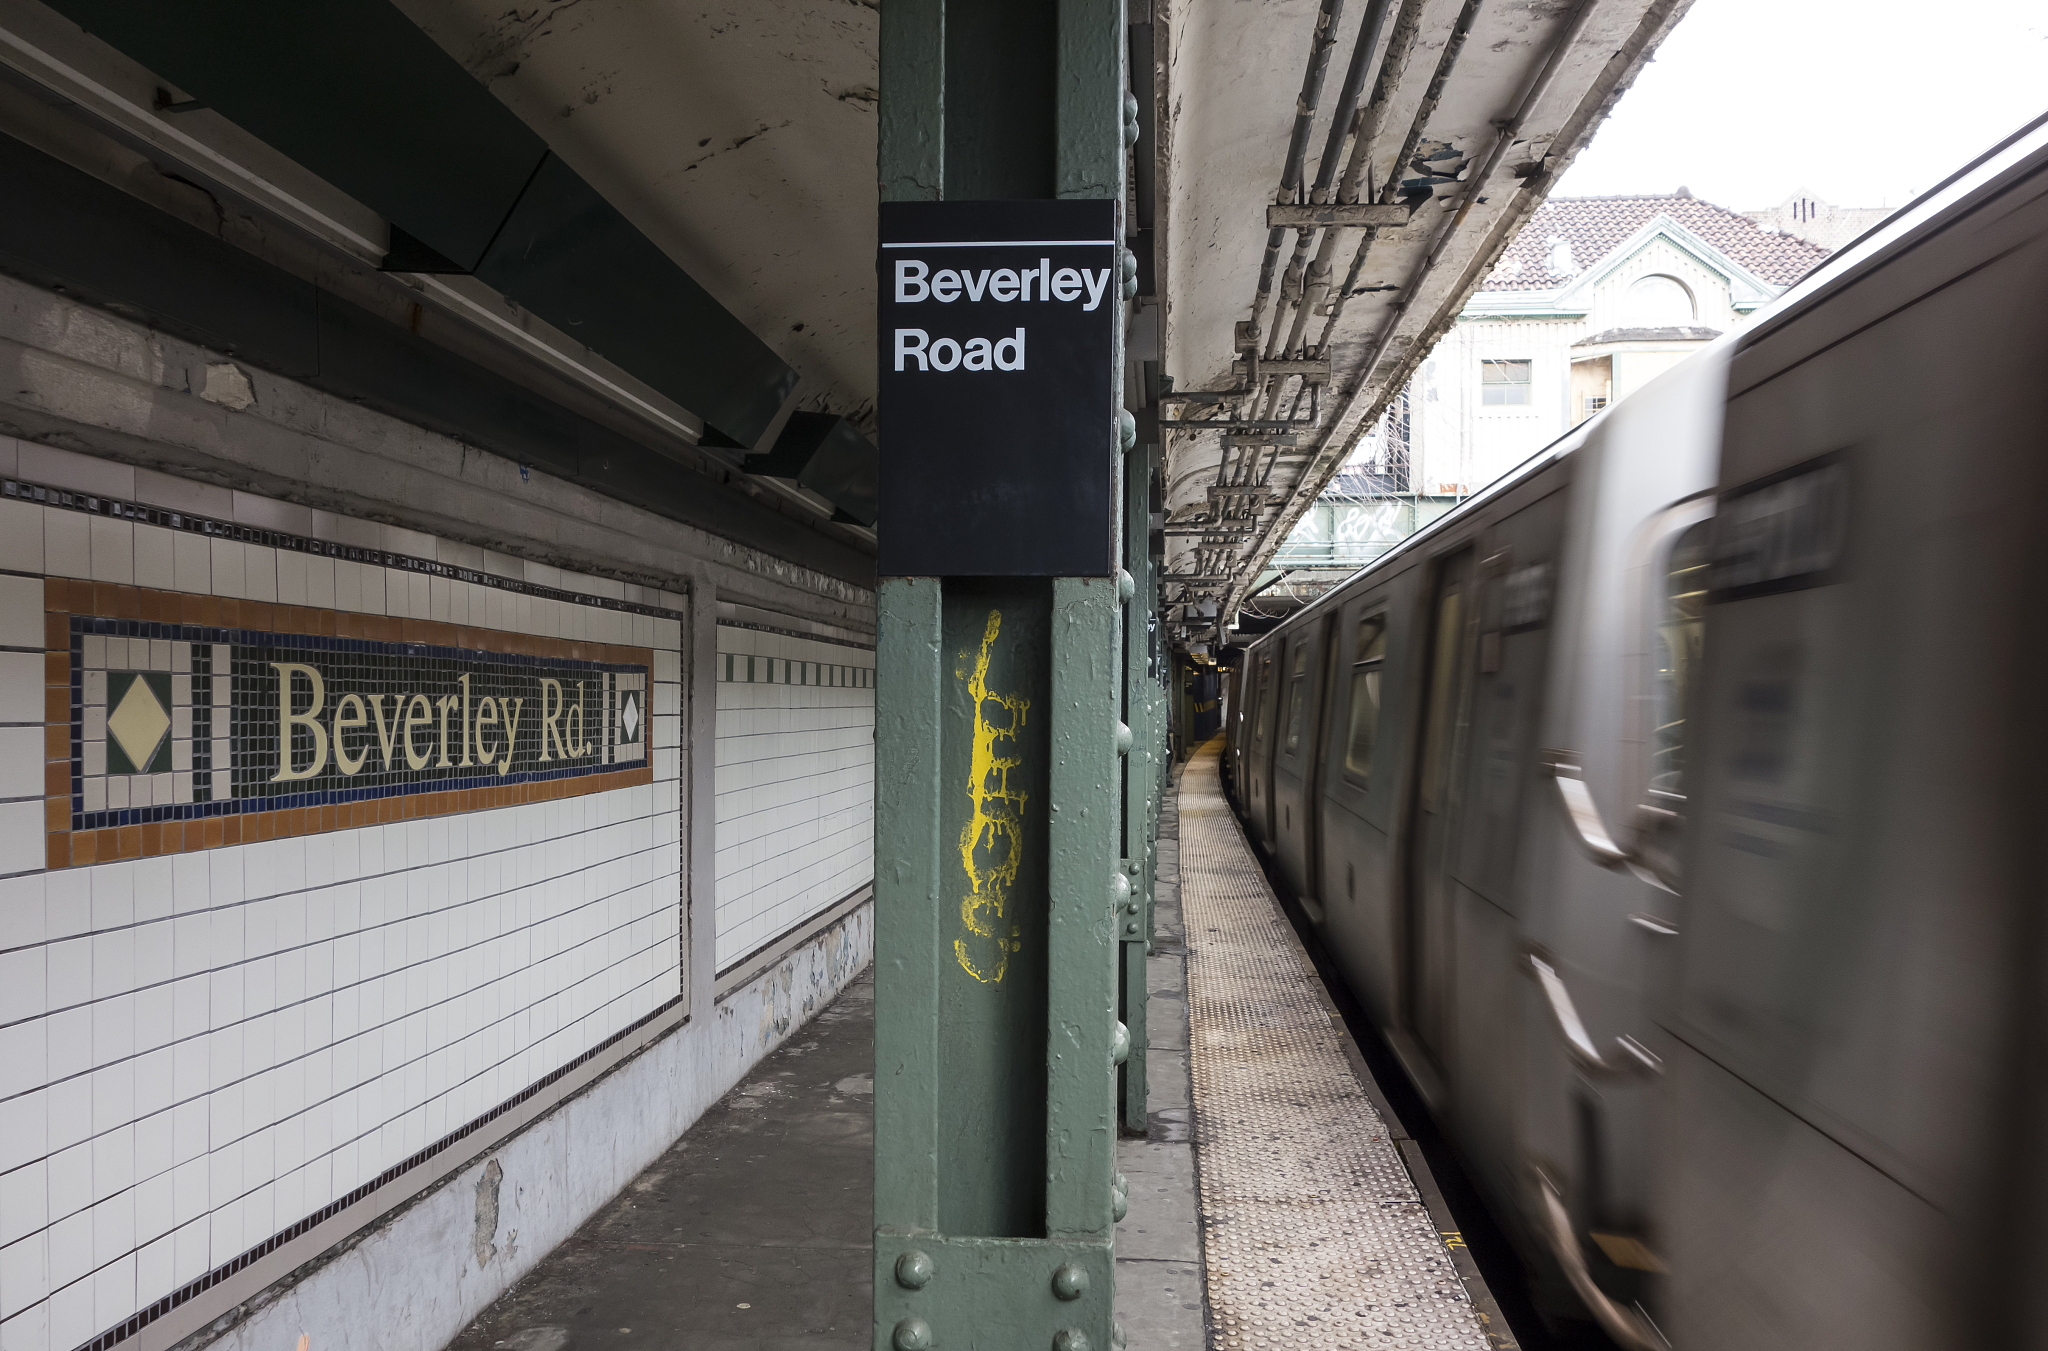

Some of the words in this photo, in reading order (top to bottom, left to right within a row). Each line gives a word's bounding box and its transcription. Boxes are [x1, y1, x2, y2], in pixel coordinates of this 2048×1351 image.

[895, 257, 1112, 312] Beverley
[894, 327, 1026, 372] Road
[269, 662, 524, 782] Beverley
[538, 678, 593, 763] Rd.
